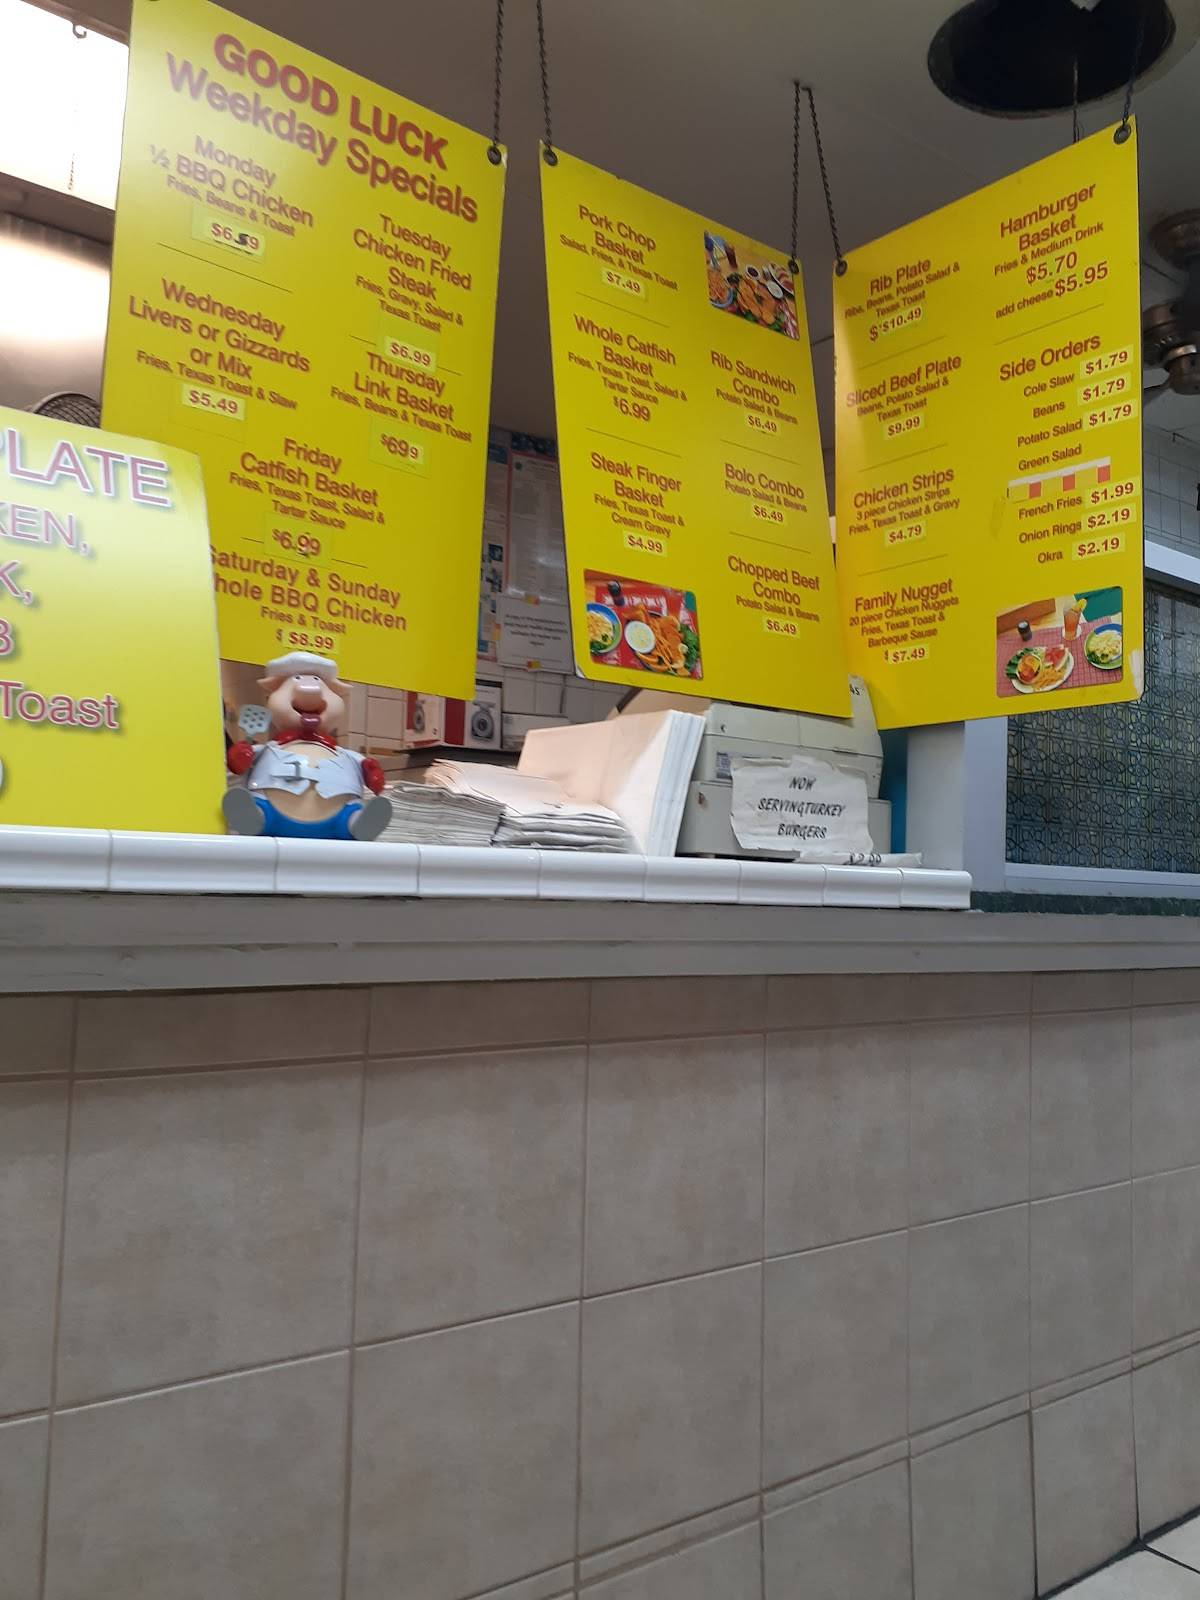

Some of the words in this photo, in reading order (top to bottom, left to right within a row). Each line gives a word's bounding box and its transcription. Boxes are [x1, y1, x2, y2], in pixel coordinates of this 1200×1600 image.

[214, 33, 339, 116] GOOD
[350, 96, 448, 171] LUCK
[166, 51, 338, 166] Weekday
[346, 138, 478, 224] Specials
[195, 135, 276, 189] Monday
[177, 154, 225, 192] BBQ
[232, 178, 313, 228] Chicken
[206, 190, 245, 216] Beans
[250, 209, 257, 222] &
[262, 212, 295, 236] Toast
[579, 204, 614, 232] Pork
[617, 222, 656, 252] Chop
[1001, 184, 1096, 238] Hamburger
[379, 213, 451, 261] Tuesday
[595, 231, 644, 265] Basket
[994, 260, 1018, 276] Fries
[1021, 254, 1028, 265] &
[1031, 236, 1072, 259] Medium
[1075, 222, 1104, 241] Drink
[1019, 214, 1076, 251] Basket
[353, 229, 425, 272] Chicken
[430, 258, 471, 291] Fried
[870, 275, 892, 295] Rib
[897, 260, 931, 283] Plate
[1026, 251, 1077, 285] $5.70
[388, 266, 437, 300] Steak
[607, 272, 640, 292] $7.49
[996, 302, 1014, 319] add
[1017, 289, 1053, 310] cheese
[1055, 261, 1108, 297] $5.95
[162, 277, 285, 342] Wednesday
[379, 299, 410, 321] Texas
[413, 312, 441, 333] Toast
[425, 302, 453, 322] Salad
[129, 295, 192, 334] Livers
[198, 323, 220, 342] or
[226, 329, 310, 372] Gizzards
[574, 314, 622, 345] Whole
[627, 334, 676, 365] Catfish
[190, 348, 212, 365] or
[218, 352, 252, 380] Mix
[391, 342, 431, 366] $6.99
[604, 346, 654, 377] Basket
[1000, 358, 1036, 381] Side
[1041, 336, 1100, 366] Orders
[177, 362, 215, 385] Texas
[219, 375, 252, 397] Toast
[256, 387, 265, 400] &
[269, 391, 297, 409] Slaw
[367, 351, 445, 398] Thursday
[711, 351, 733, 371] Rib
[736, 360, 796, 394] Sandwich
[846, 380, 886, 407] Sliced
[890, 366, 921, 392] Beef
[926, 356, 961, 378] Plate
[1024, 383, 1046, 397] Cole
[1050, 373, 1074, 389] Slaw
[1086, 351, 1128, 375] $1.79
[190, 390, 238, 414] $5.49
[354, 372, 390, 400] Link
[397, 386, 454, 422] Basket
[614, 396, 650, 421] $6.99
[733, 378, 779, 406] Combo
[1033, 401, 1065, 418] Beans
[1083, 378, 1125, 401] $1.79
[365, 398, 398, 418] Beans
[401, 410, 409, 422] &
[412, 413, 441, 433] Texas
[445, 424, 472, 442] Toast
[888, 416, 920, 436] $9.99
[1018, 431, 1049, 447] Potato
[1053, 418, 1083, 437] Salad
[1089, 404, 1132, 426] $1.79
[0, 428, 171, 507] LATE
[284, 438, 342, 475] Friday
[591, 451, 633, 478] Steak
[637, 465, 681, 492] Finger
[1019, 455, 1049, 471] Green
[1052, 444, 1082, 461] Salad
[240, 452, 309, 487] Catfish
[316, 473, 378, 506] Basket
[614, 480, 664, 507] Basket
[725, 463, 755, 485] Bolo
[759, 473, 804, 499] Combo
[854, 483, 908, 508] Chicken
[912, 469, 954, 491] Strips
[266, 481, 301, 500] Texas
[343, 503, 374, 521] Salad
[377, 512, 385, 524] &
[754, 505, 783, 522] $6.49
[857, 511, 862, 521] 3
[888, 495, 922, 511] Chicken
[925, 488, 950, 501] Strips
[899, 508, 922, 521] Toast
[924, 505, 931, 515] &
[933, 499, 959, 512] Gravy
[1019, 502, 1054, 519] French
[1057, 496, 1082, 509] Fries
[1091, 482, 1134, 504] $1.99
[310, 510, 346, 529] Sauce
[889, 525, 922, 543] $4.79
[1019, 529, 1049, 543] Onion
[1052, 521, 1082, 535] Rings
[1088, 508, 1130, 528] $2.19
[628, 535, 662, 553] $4.99
[1038, 551, 1063, 564] Okra
[1078, 538, 1119, 556] $2.19
[306, 569, 320, 587] &
[328, 573, 400, 608] Sunday
[728, 555, 788, 582] Chopped
[792, 570, 819, 590] Beef
[213, 573, 262, 600] hole
[271, 584, 319, 612] BBQ
[326, 598, 407, 631] Chicken
[753, 581, 800, 605] Combo
[855, 591, 897, 612] Family
[901, 578, 952, 602] Nugget
[885, 605, 919, 618] Chicken
[921, 596, 959, 611] Nuggets
[261, 606, 293, 623] Fries
[298, 614, 306, 626] &
[311, 616, 346, 635] Toast
[767, 619, 796, 634] $6.49
[289, 631, 334, 650] $8.99
[892, 648, 925, 662] $7.49
[0, 679, 119, 729] Toast
[789, 777, 816, 790] NOW
[778, 824, 827, 840] BURGERS
